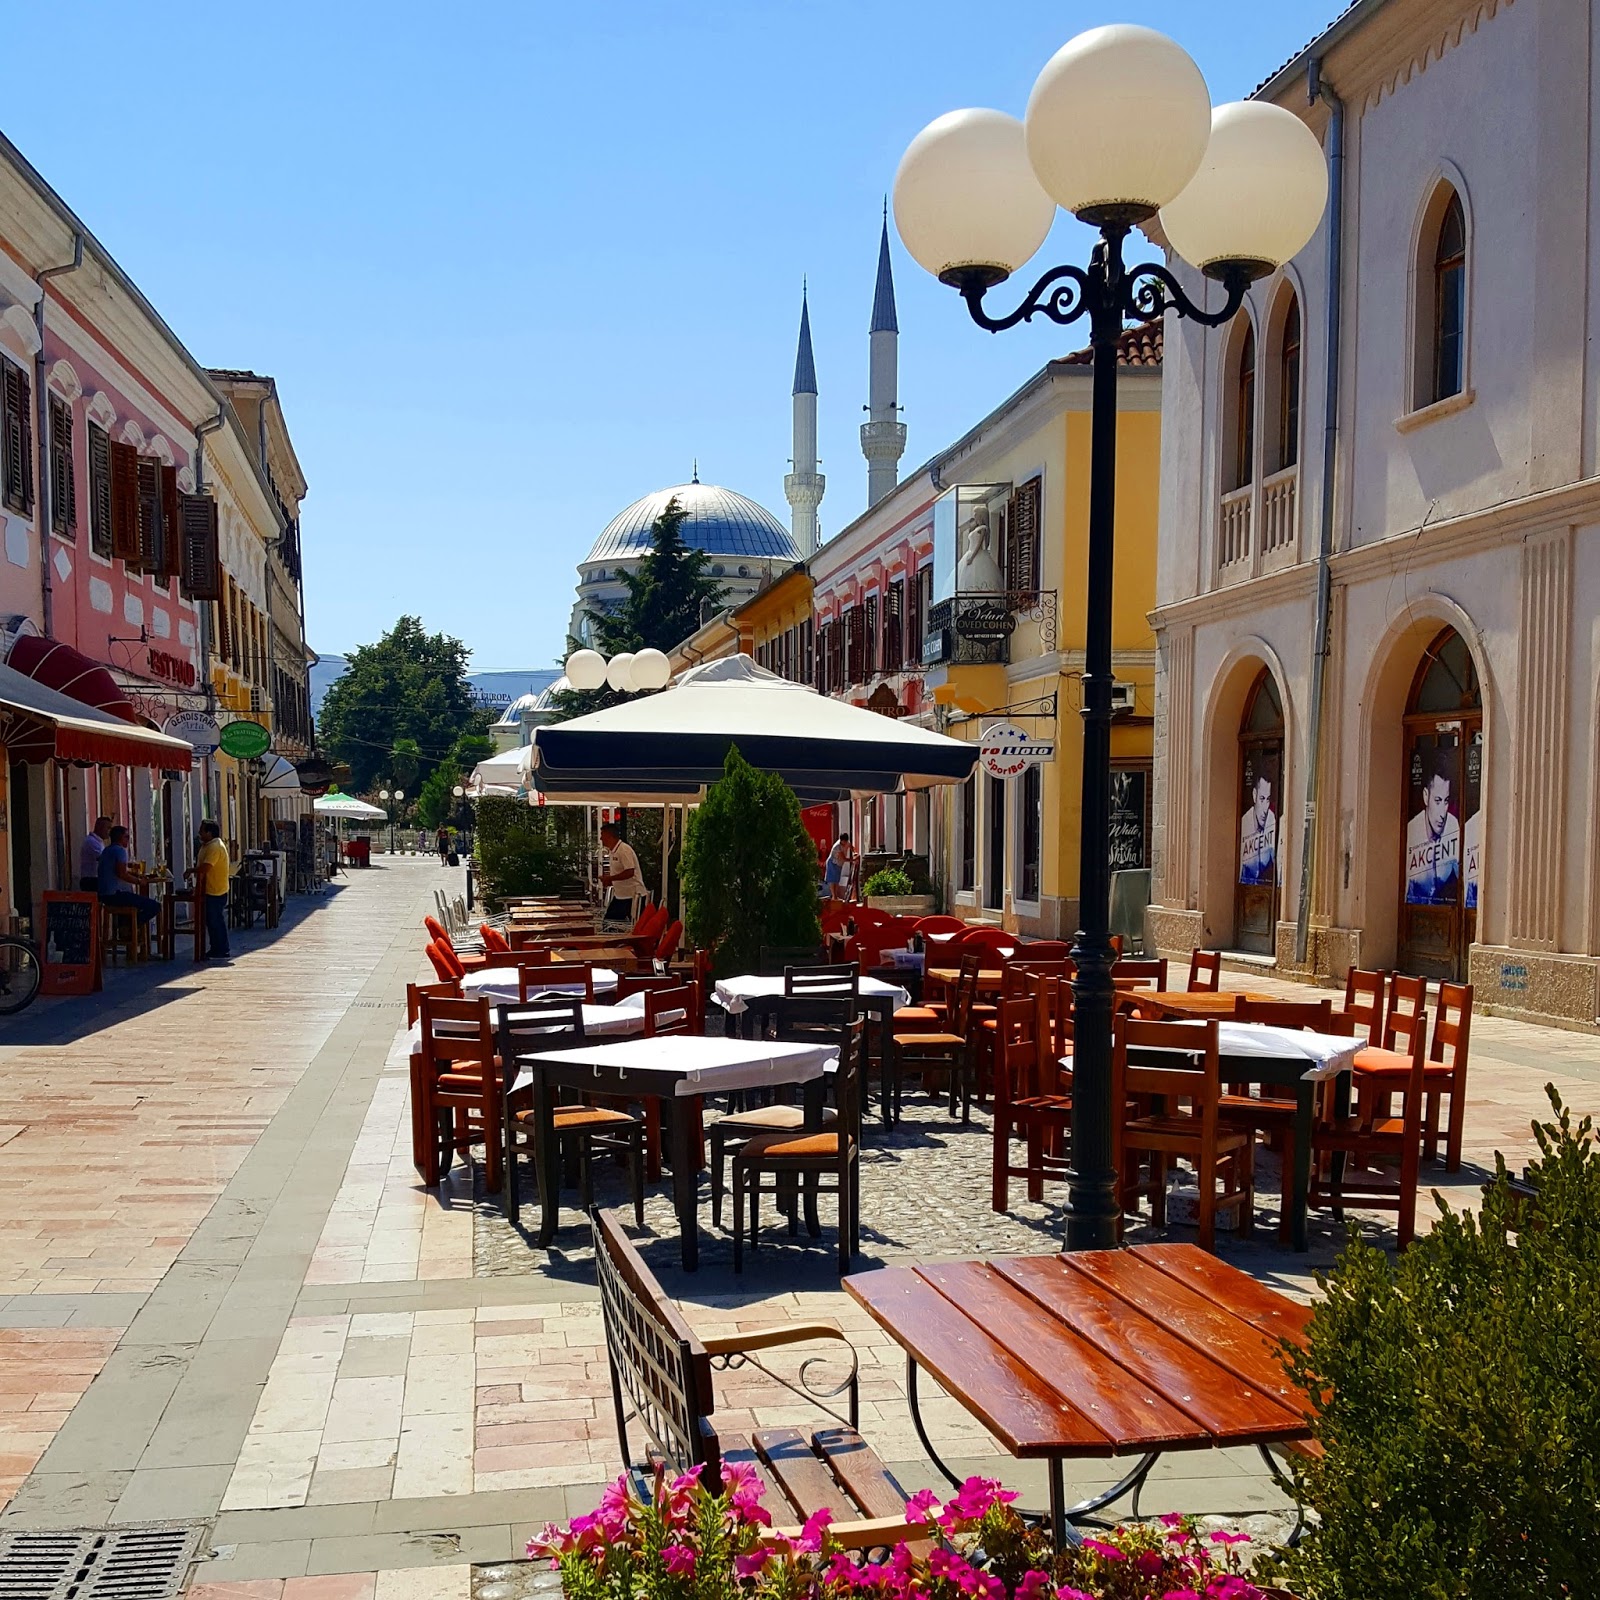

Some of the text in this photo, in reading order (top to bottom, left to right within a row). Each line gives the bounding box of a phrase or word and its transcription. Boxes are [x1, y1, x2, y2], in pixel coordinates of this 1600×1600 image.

[968, 607, 1005, 621] Velari
[957, 621, 1014, 630] OVED COHEN
[481, 692, 512, 701] EUROPA
[861, 706, 906, 717] ETRO
[171, 712, 216, 730] QENDISTARI
[183, 721, 205, 730] Arta
[981, 747, 1001, 755] ro
[987, 758, 1027, 775] SportBar
[1109, 822, 1139, 837] White
[1243, 830, 1274, 856] AKCENT
[1409, 838, 1458, 871] AKCENT
